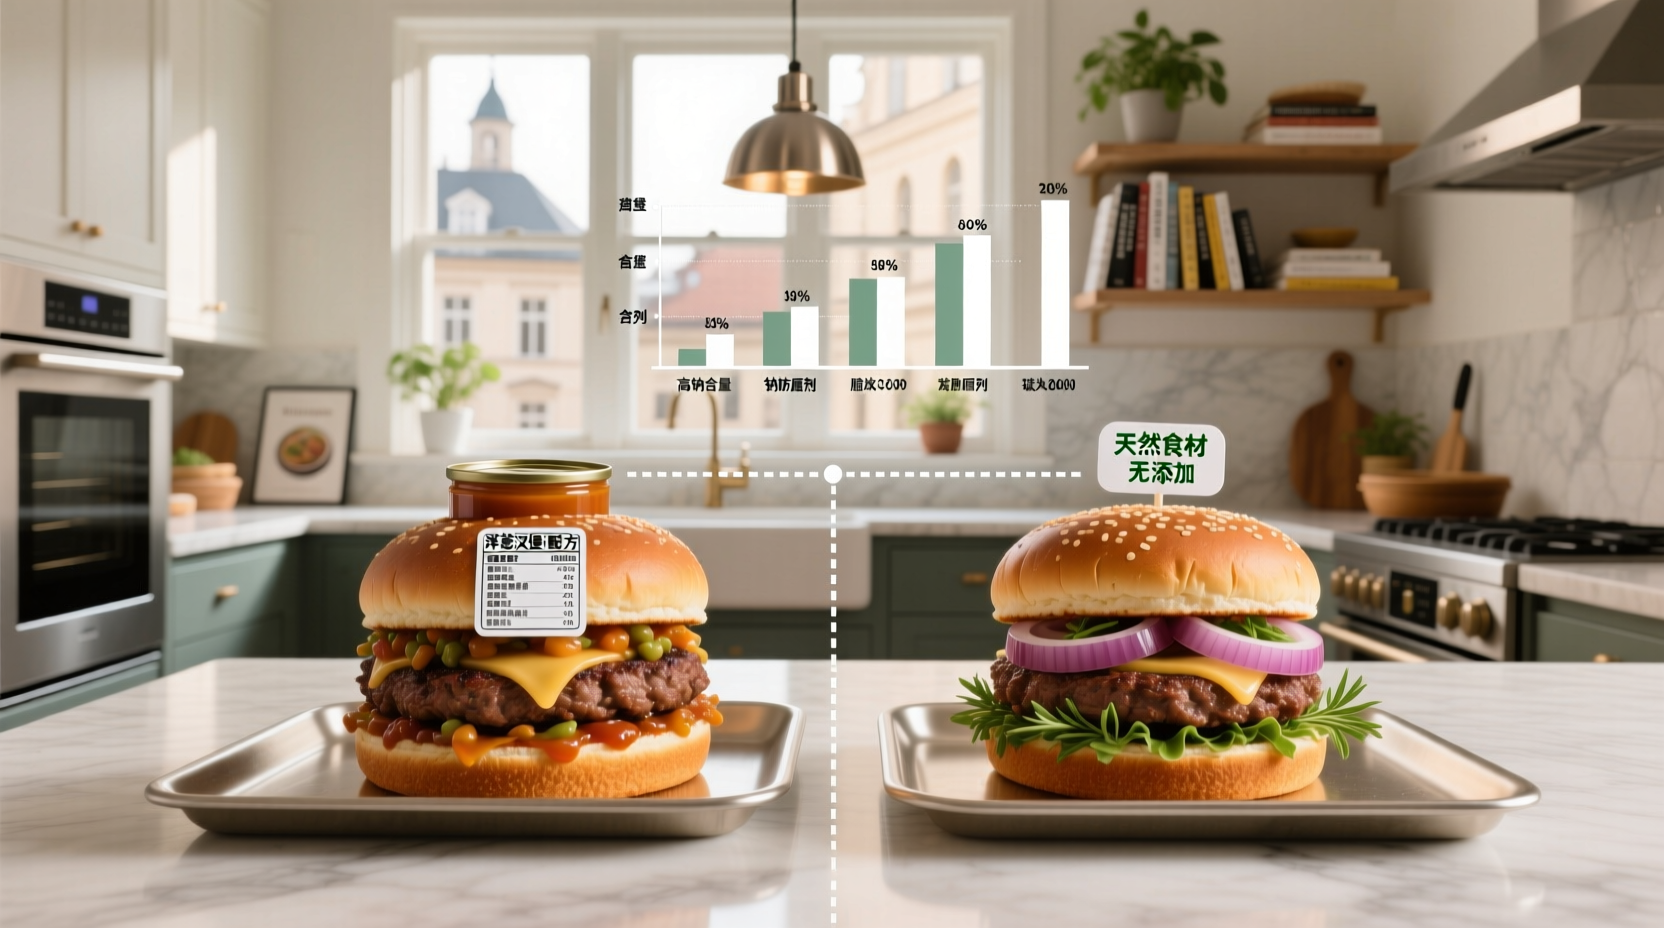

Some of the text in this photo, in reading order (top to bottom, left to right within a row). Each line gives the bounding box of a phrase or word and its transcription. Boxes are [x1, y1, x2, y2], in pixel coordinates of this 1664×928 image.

[1114, 431, 1208, 458] 天然食材
[1128, 461, 1195, 485] 无添加
